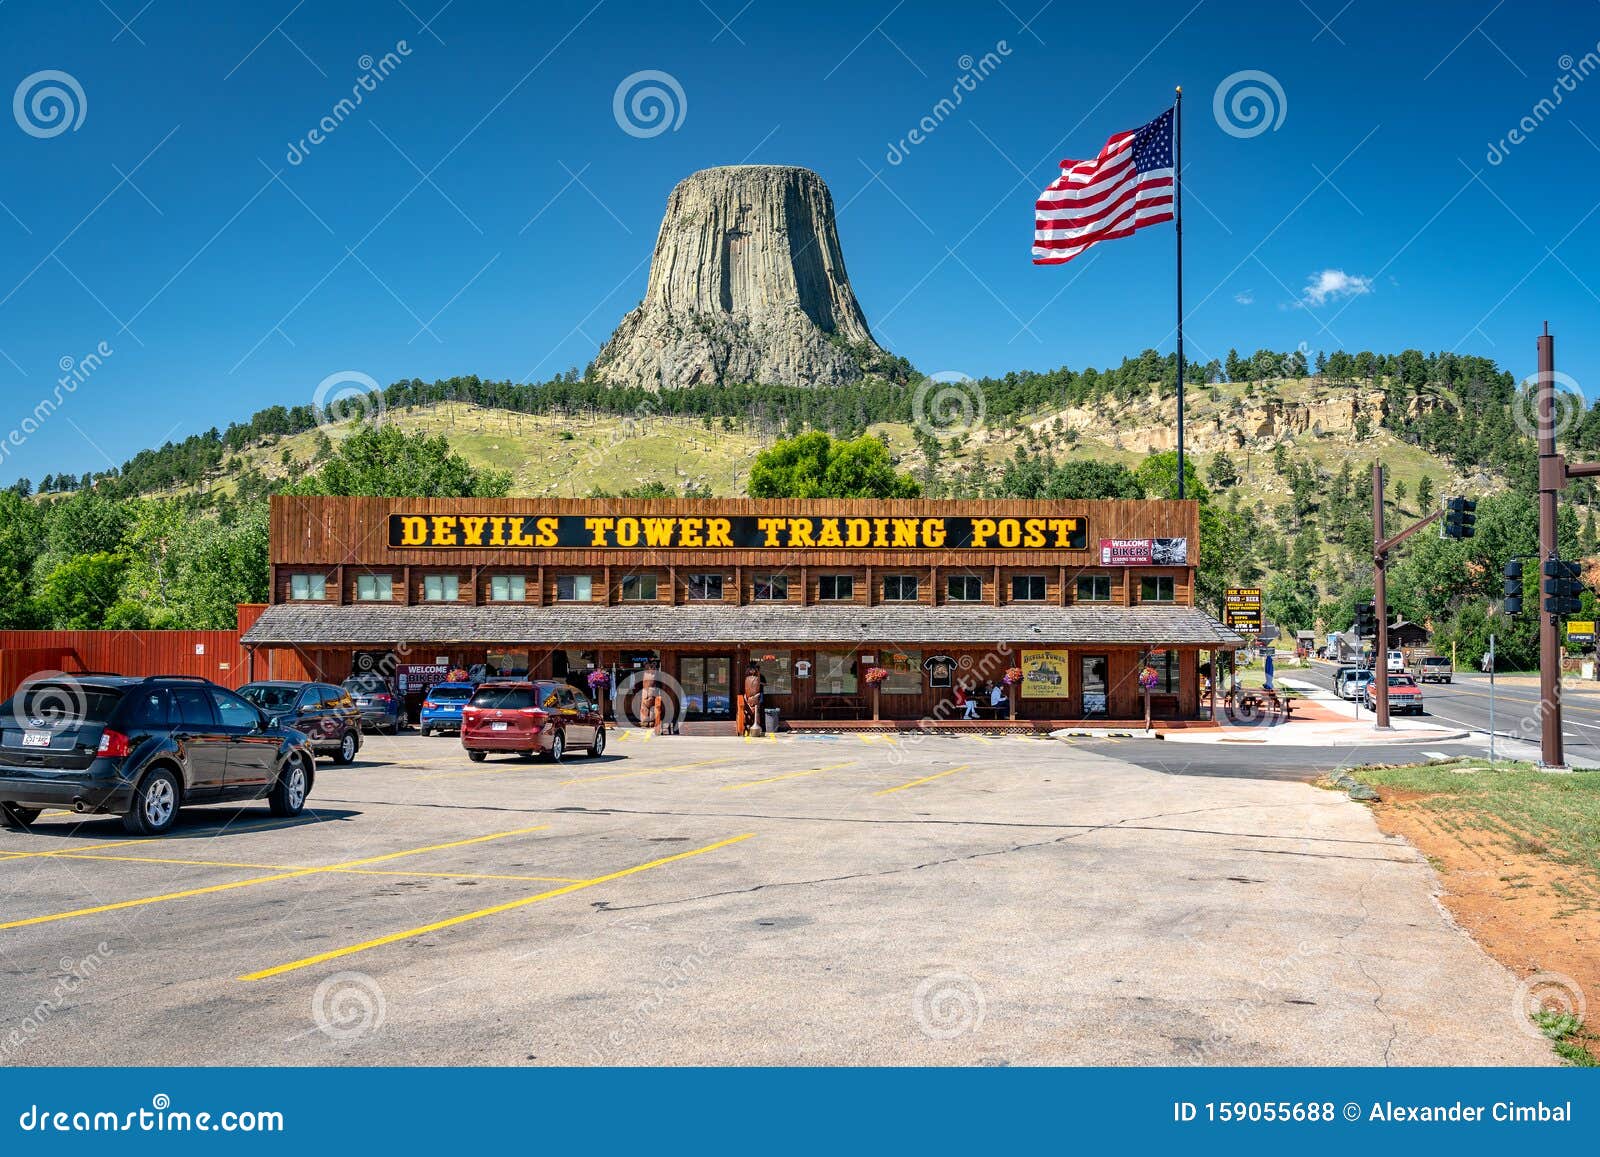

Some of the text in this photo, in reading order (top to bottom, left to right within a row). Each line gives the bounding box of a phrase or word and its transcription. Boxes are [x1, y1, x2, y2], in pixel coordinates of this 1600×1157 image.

[401, 516, 1077, 548] DEVILS TOWER TRADING POST
[1112, 547, 1149, 556] BIKERS
[408, 674, 447, 682] BIKERS
